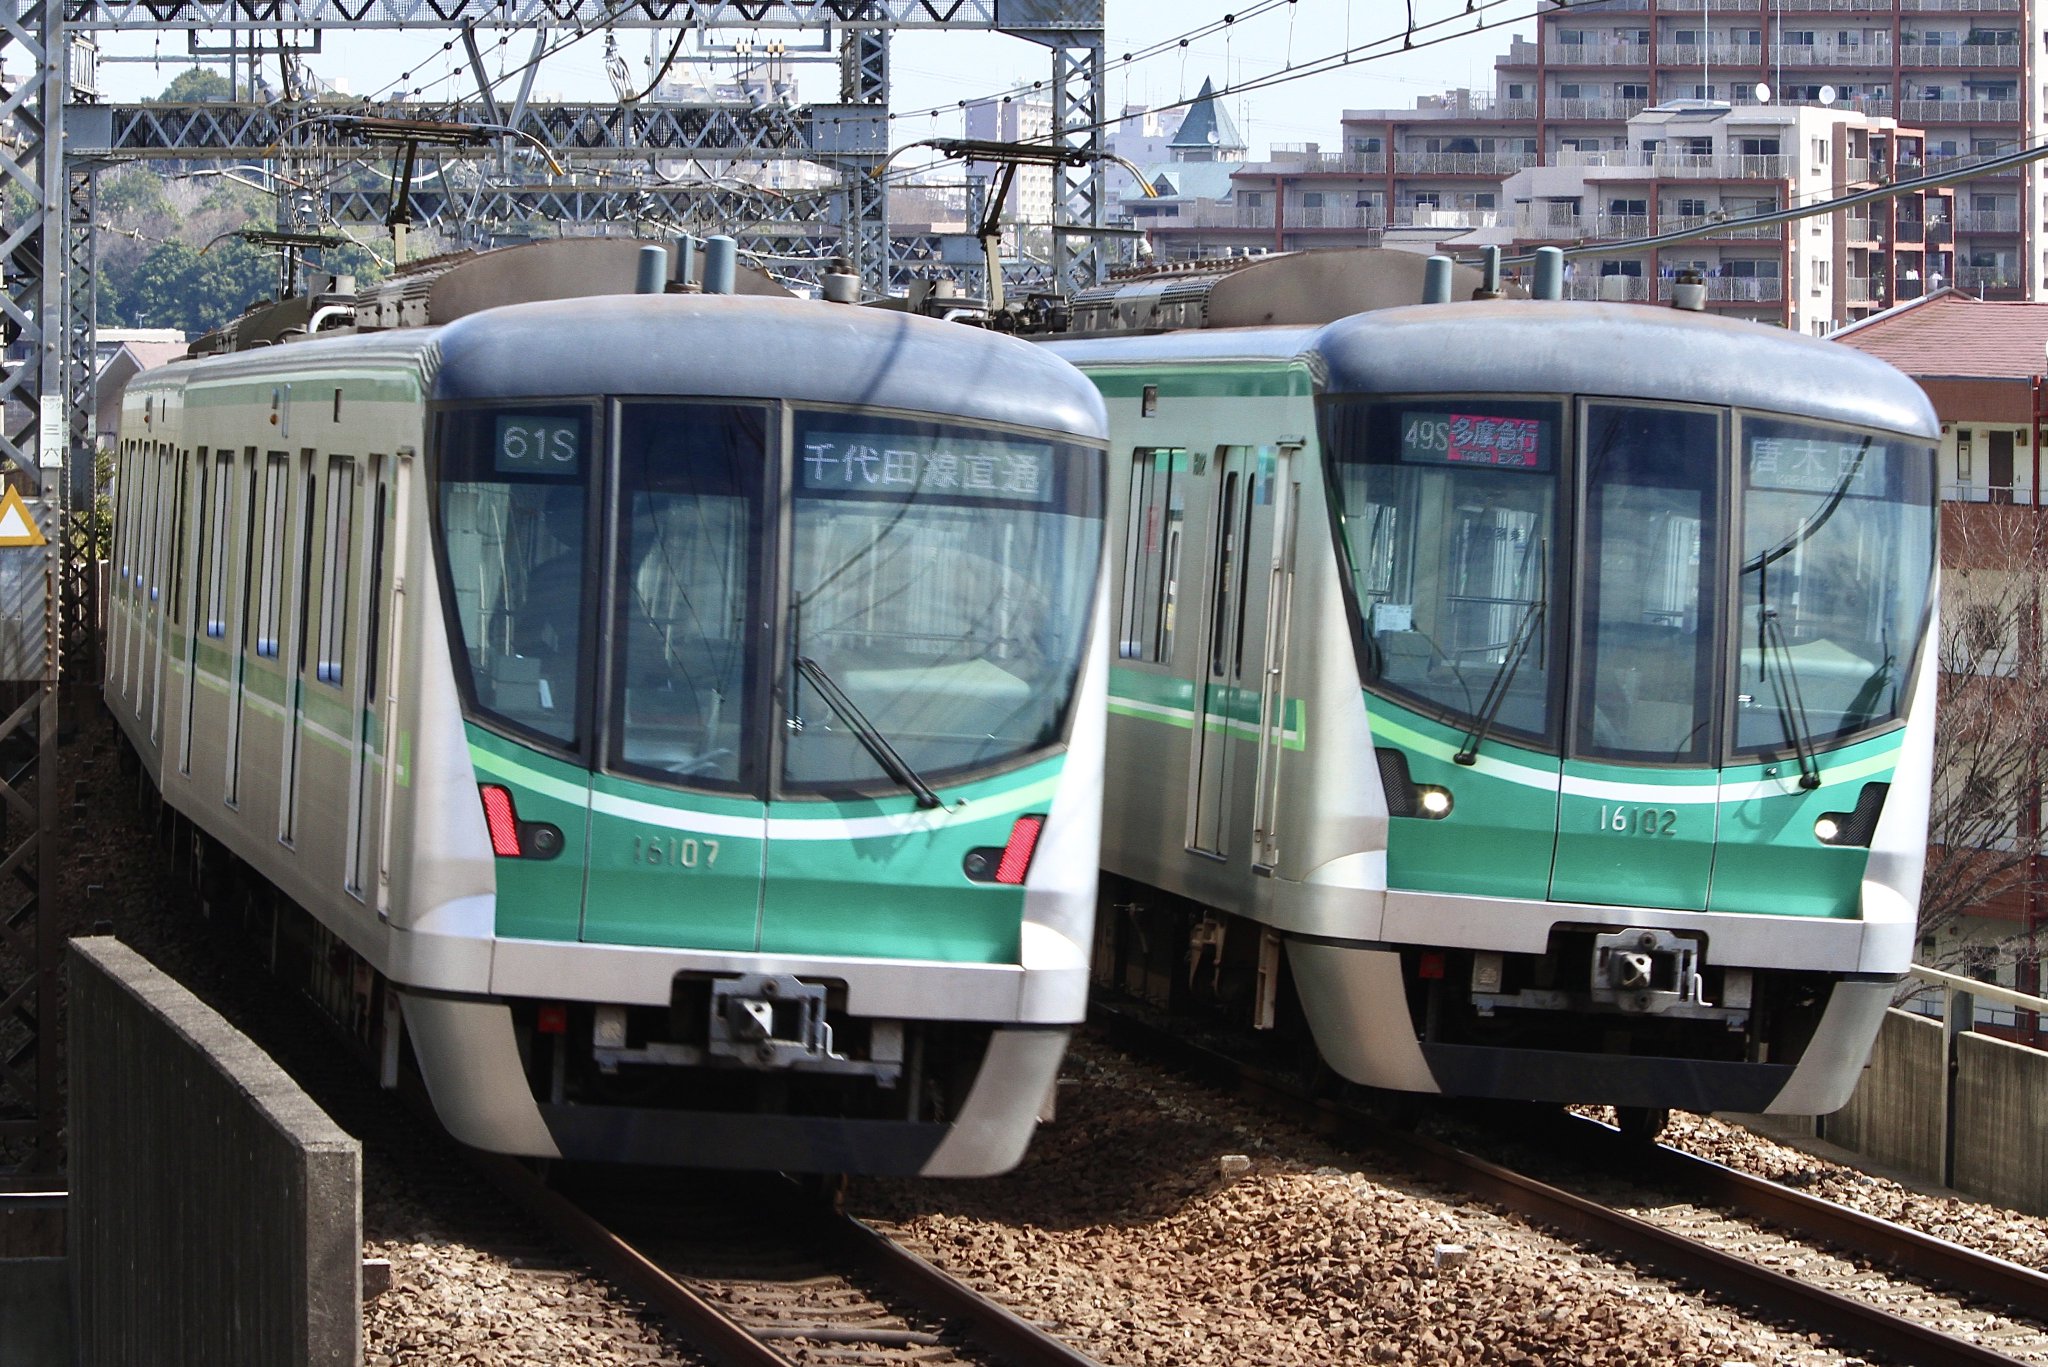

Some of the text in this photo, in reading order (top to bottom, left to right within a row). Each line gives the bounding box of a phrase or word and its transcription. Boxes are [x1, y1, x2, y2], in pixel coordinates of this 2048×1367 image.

[504, 426, 576, 461] 61S
[1405, 419, 1449, 451] 49S
[1451, 417, 1539, 453] 多摩急行
[803, 443, 1039, 494] 千代田線直通
[1750, 438, 1866, 480] 唐木田
[1599, 805, 1678, 835] 16102
[633, 835, 720, 869] 16107
